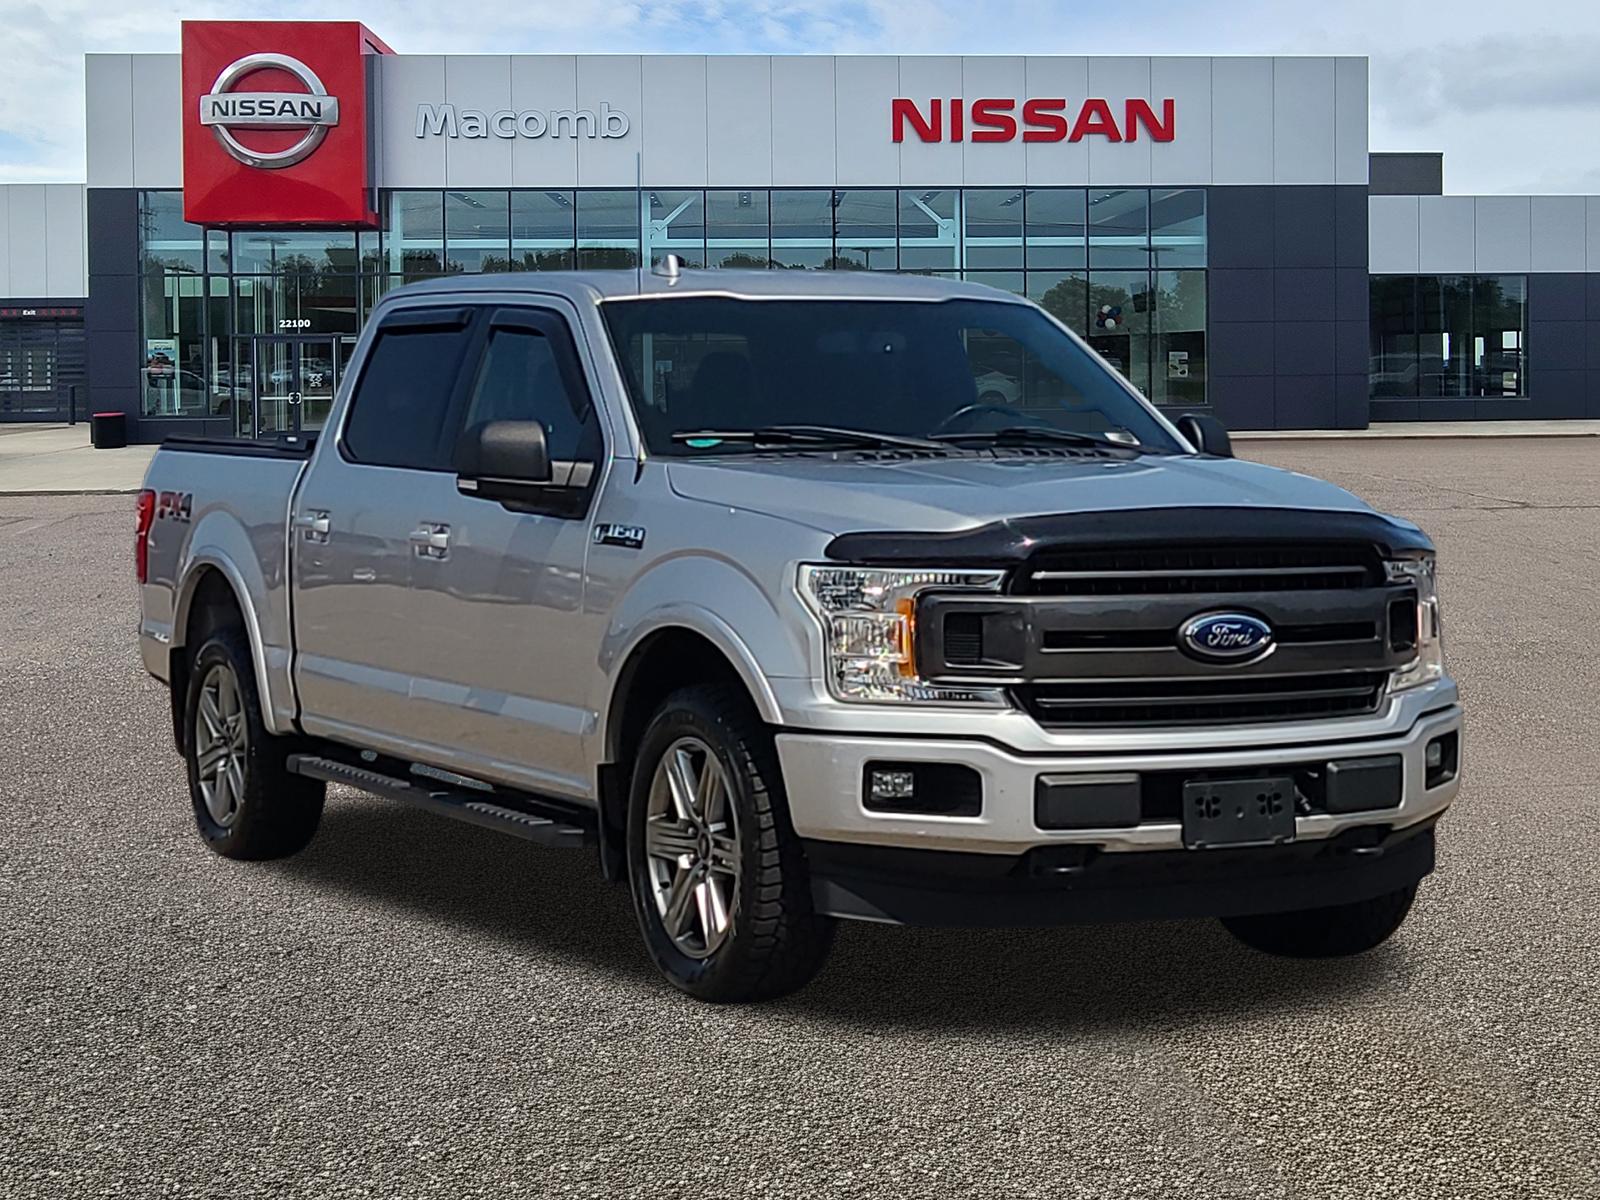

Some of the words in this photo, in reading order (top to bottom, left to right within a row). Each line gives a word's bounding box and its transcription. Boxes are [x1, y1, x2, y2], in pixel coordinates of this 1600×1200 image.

[211, 99, 322, 119] NISSAN
[415, 102, 630, 140] Macomb
[891, 98, 1175, 143] NISSAN
[279, 319, 311, 328] 22100
[1207, 622, 1253, 647] Ford
